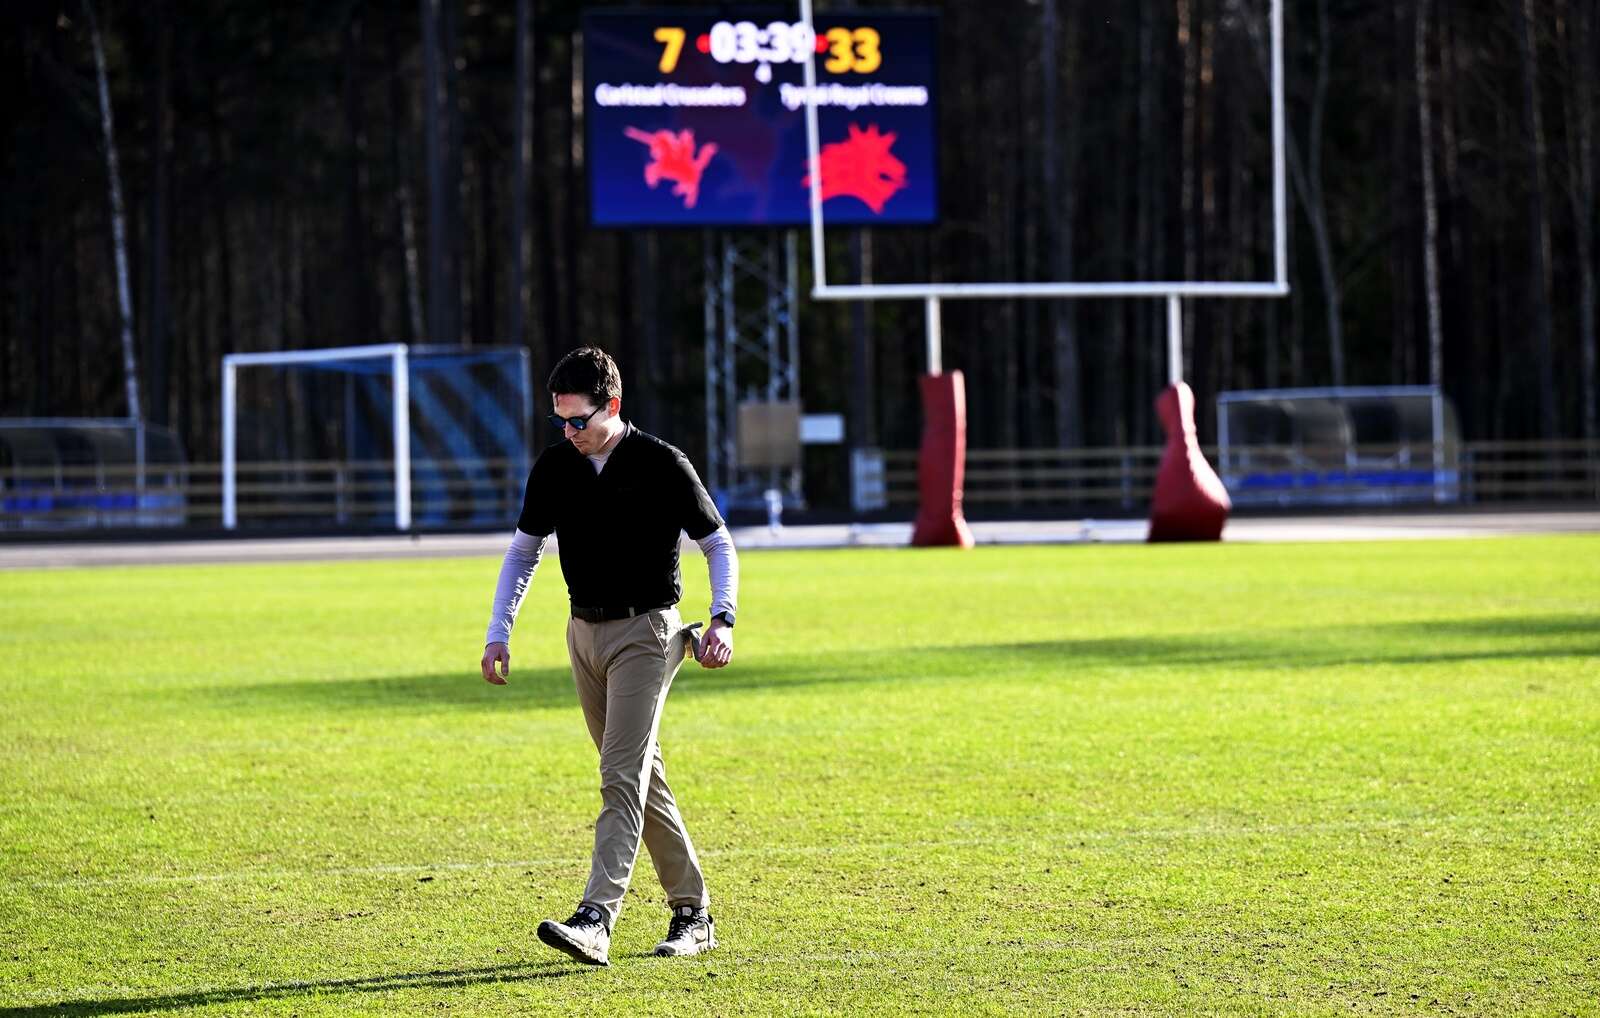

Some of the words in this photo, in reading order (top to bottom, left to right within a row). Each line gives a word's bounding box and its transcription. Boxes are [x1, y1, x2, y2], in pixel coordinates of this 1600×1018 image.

[654, 27, 686, 73] 7
[710, 21, 816, 63] 03:39
[825, 27, 882, 73] 33
[830, 83, 871, 110] Royal
